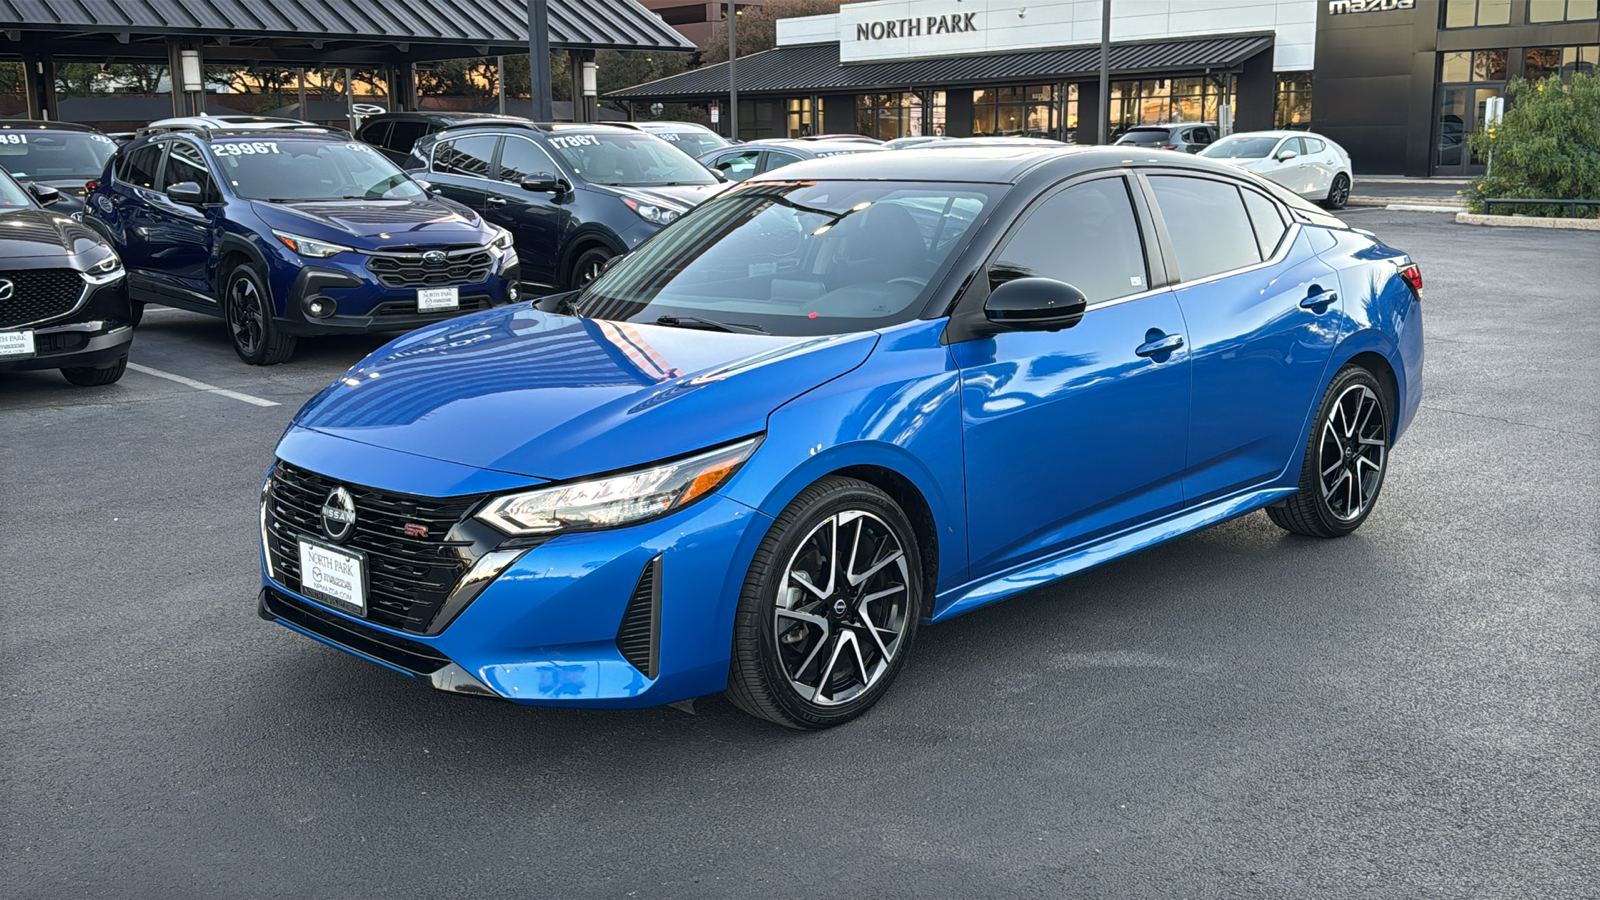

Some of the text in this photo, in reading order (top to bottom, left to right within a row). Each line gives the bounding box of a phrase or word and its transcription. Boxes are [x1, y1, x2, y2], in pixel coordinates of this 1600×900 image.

[856, 12, 977, 41] NORTH PARK
[211, 142, 280, 157] 29967
[548, 135, 601, 150] 17867
[322, 506, 355, 524] NISSAN
[404, 522, 429, 538] SR
[308, 551, 354, 577] NORTH PARK
[314, 582, 352, 601] NPMAZDA.COM
